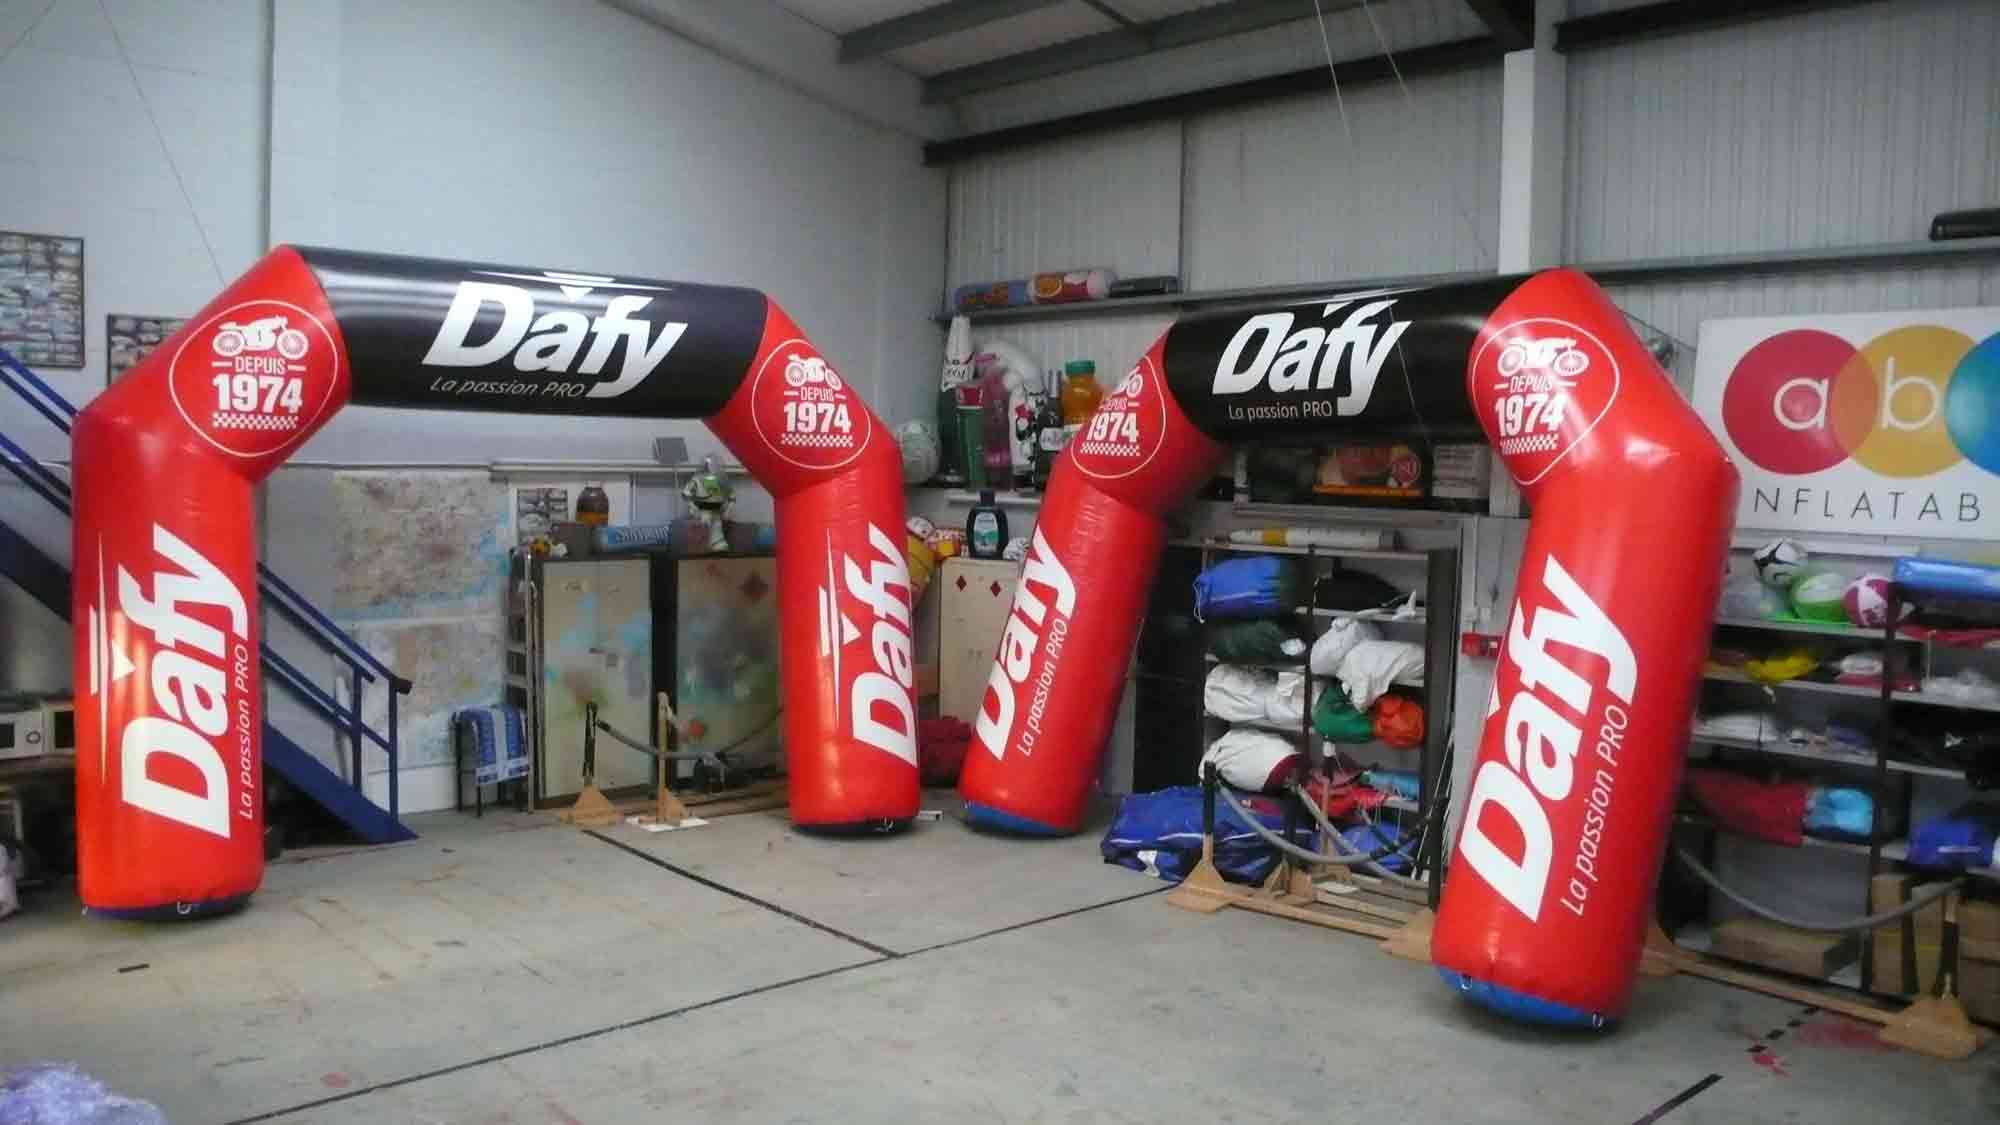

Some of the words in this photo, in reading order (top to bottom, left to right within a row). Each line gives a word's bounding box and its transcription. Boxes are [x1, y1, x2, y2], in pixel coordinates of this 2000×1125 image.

[421, 281, 689, 398] Dafy
[1212, 299, 1412, 416] Dafy
[235, 355, 286, 375] DEPUIS
[430, 376, 454, 393] La
[456, 378, 540, 398] passion
[542, 381, 585, 398] PRO
[1510, 375, 1553, 393] DEPUIS
[212, 373, 303, 414] 1974
[800, 386, 835, 401] DEPUIS
[1228, 404, 1244, 420] La
[1248, 402, 1299, 423] passion
[1303, 401, 1333, 418] PRO
[1496, 393, 1567, 437] 1974
[783, 401, 852, 433] 1974
[1086, 411, 1139, 443] 1974
[844, 521, 918, 768] Dafy
[118, 521, 248, 839] Dafy
[234, 643, 249, 693] PRO
[1016, 732, 1034, 757] La
[1026, 660, 1057, 734] passion
[1045, 619, 1068, 659] PRO
[238, 699, 254, 788] passion
[1459, 553, 1638, 923] Dafy
[239, 798, 254, 820] La
[1560, 877, 1586, 917] La
[1575, 769, 1614, 882] passion
[1596, 705, 1629, 767] PRO
